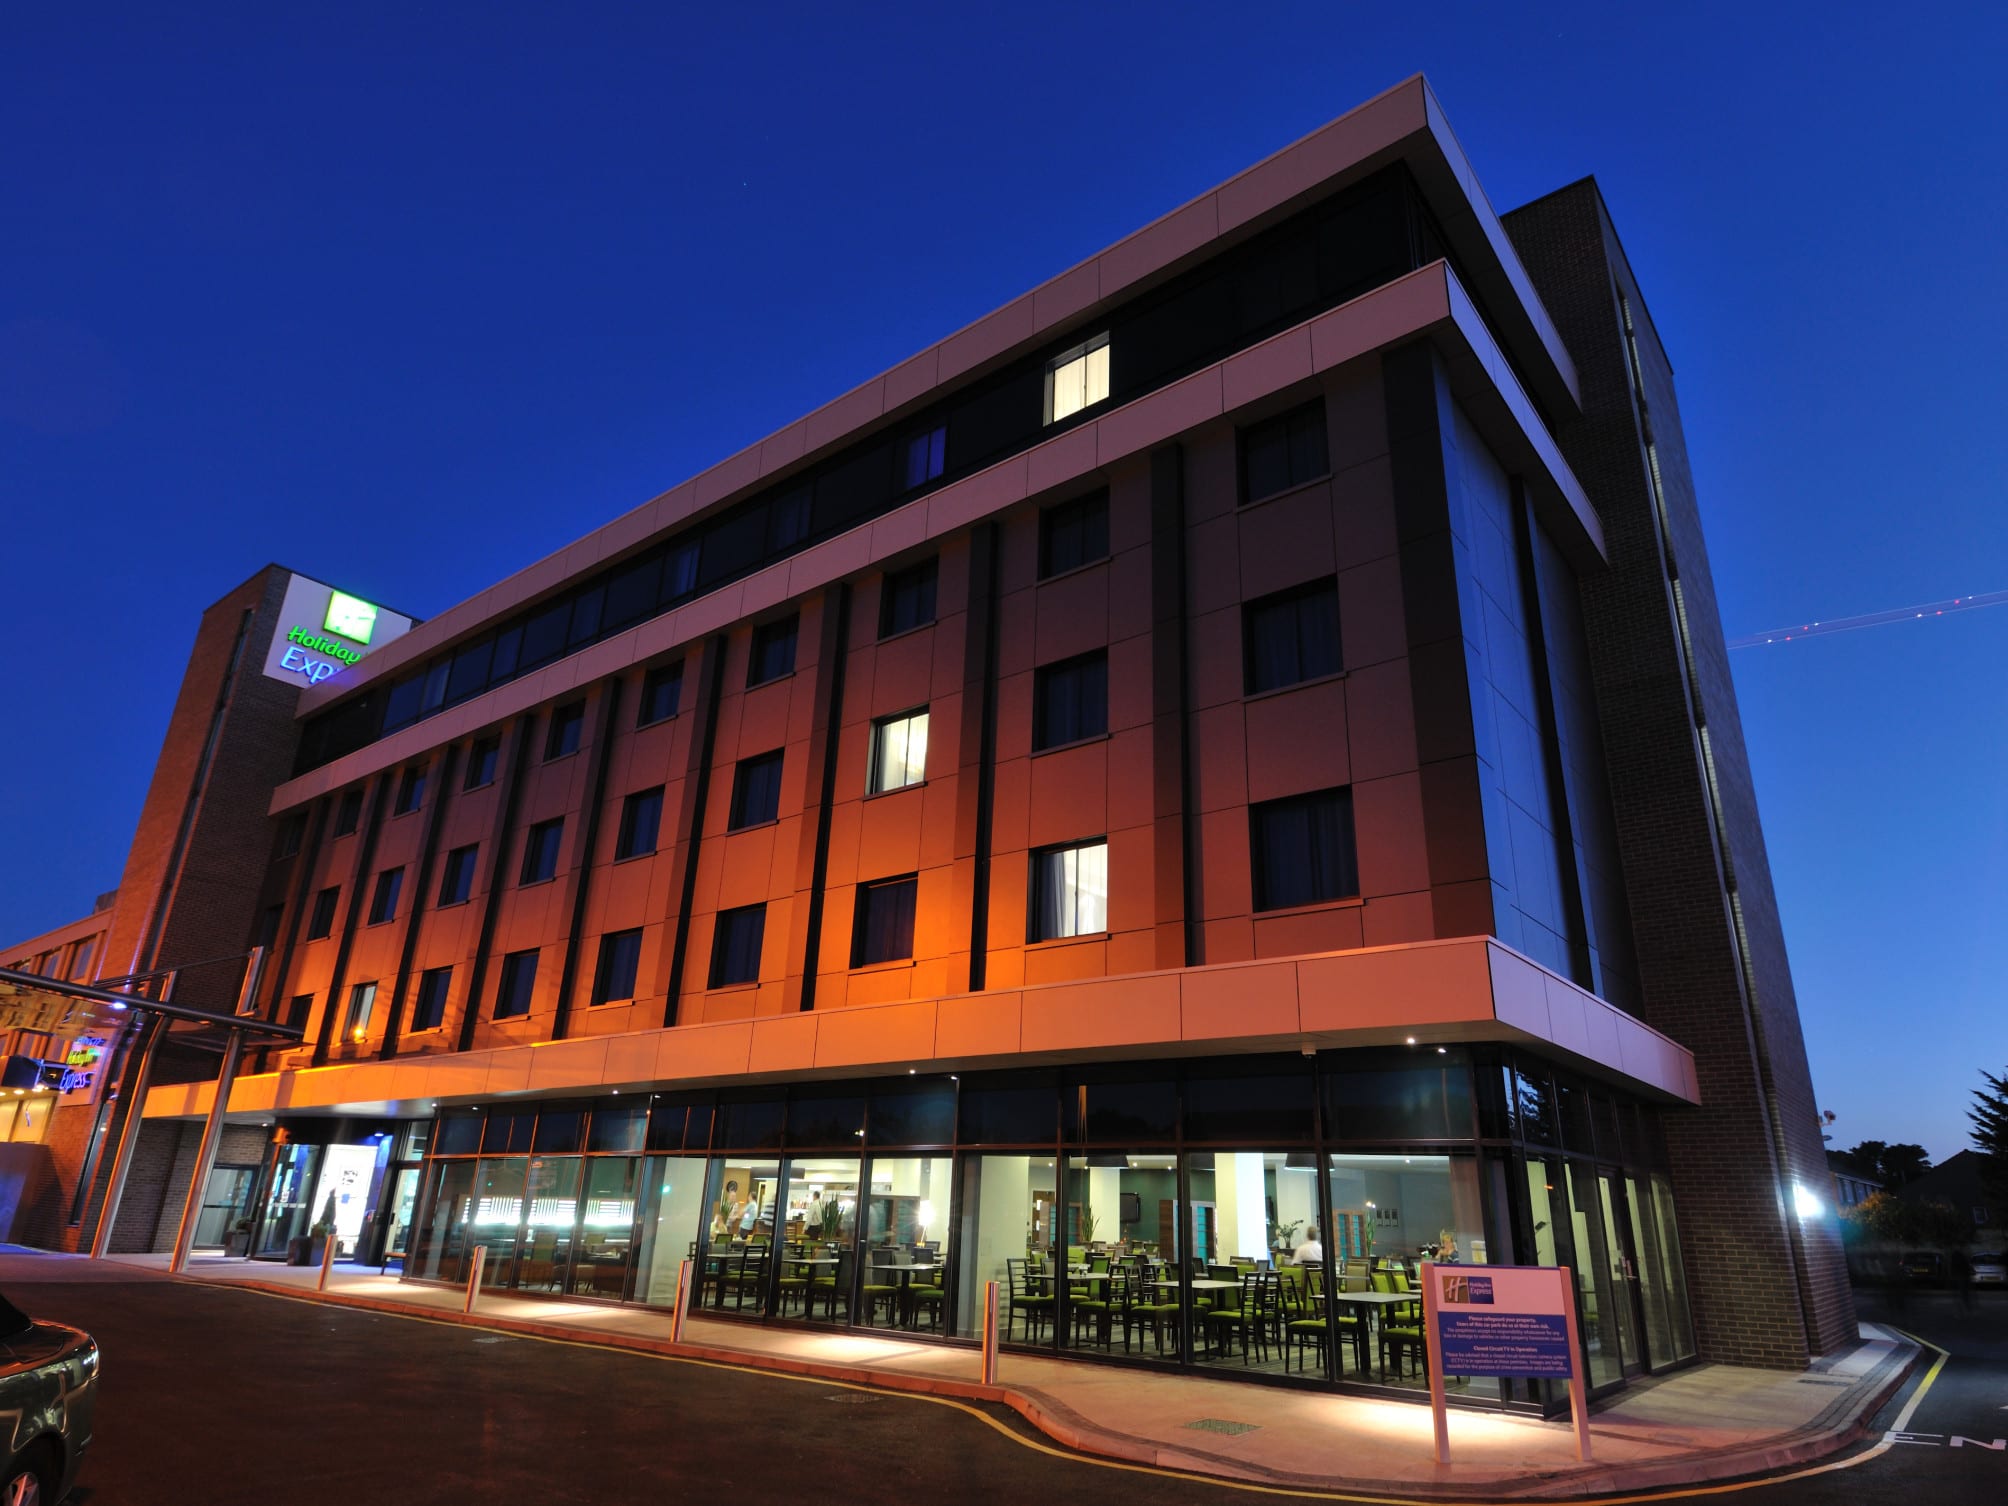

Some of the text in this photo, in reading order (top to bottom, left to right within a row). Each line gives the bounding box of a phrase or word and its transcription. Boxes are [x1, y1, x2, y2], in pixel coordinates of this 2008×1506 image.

[287, 625, 361, 665] Holiday
[280, 646, 340, 685] Exp
[59, 1069, 90, 1094] Express
[1470, 1287, 1492, 1296] Express
